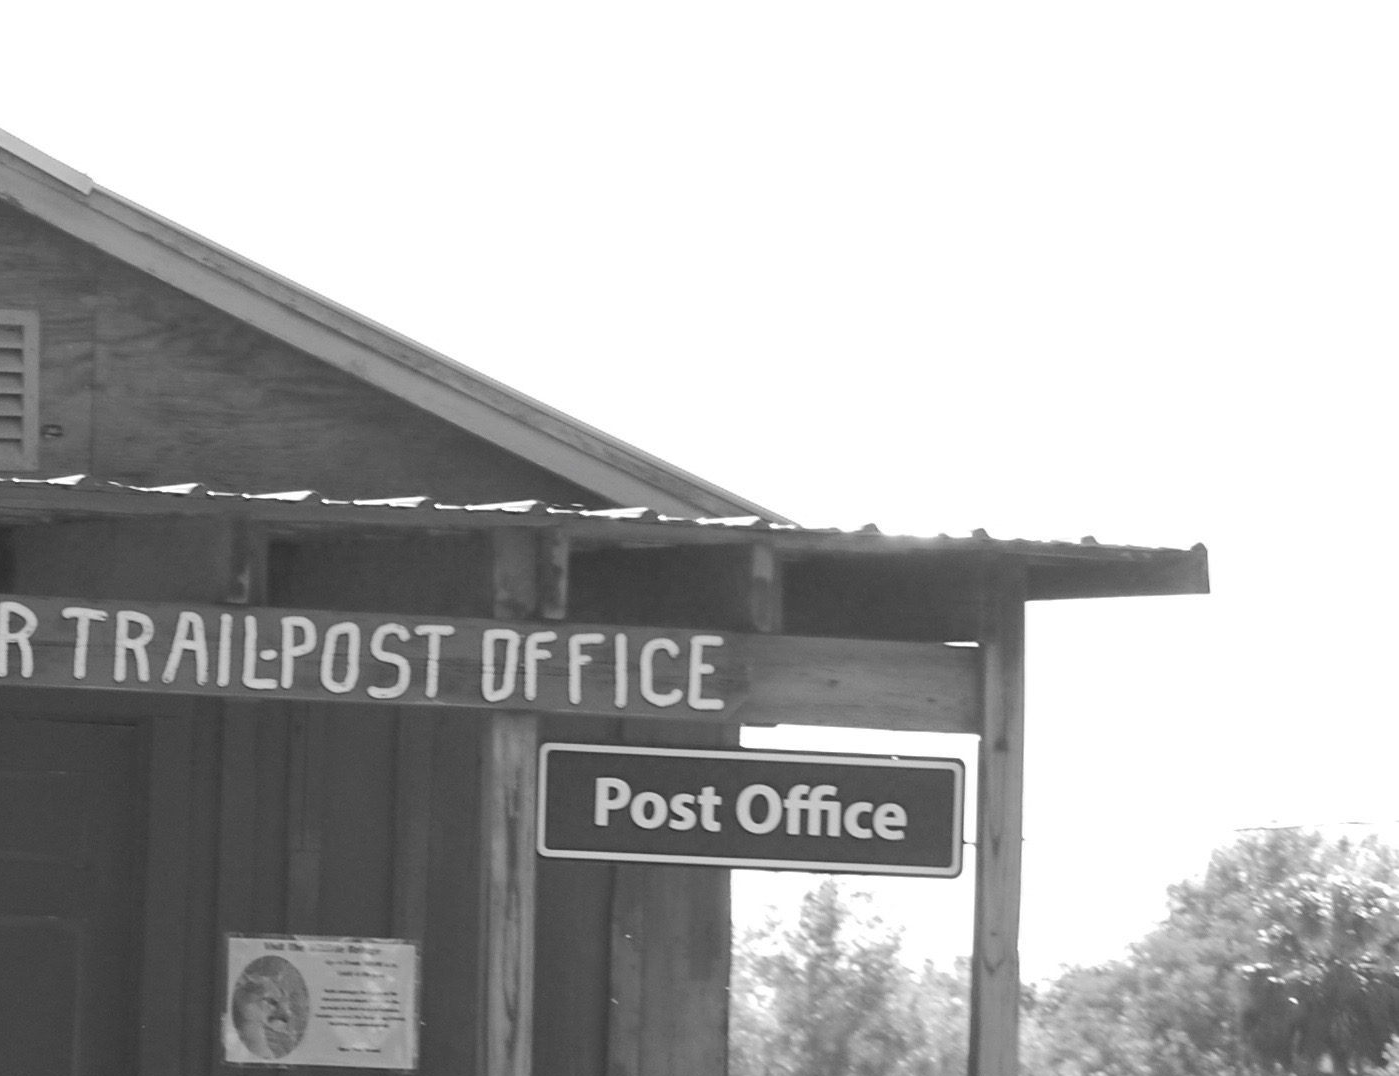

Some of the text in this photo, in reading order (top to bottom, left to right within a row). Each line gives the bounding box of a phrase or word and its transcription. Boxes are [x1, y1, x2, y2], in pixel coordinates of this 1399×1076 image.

[481, 628, 725, 711] OFFICE
[594, 777, 908, 841] Post Office
